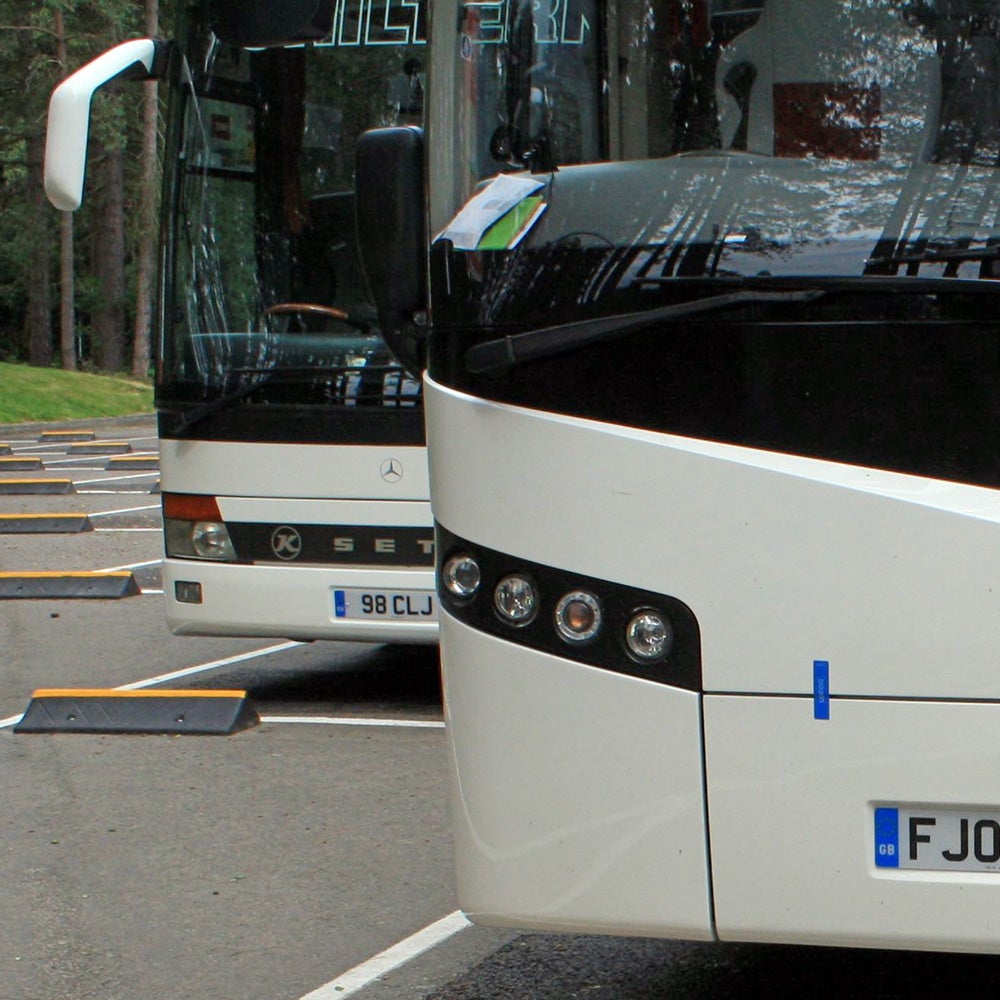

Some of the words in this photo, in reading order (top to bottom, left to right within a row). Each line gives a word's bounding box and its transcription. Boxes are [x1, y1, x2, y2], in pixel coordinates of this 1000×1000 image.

[361, 594, 387, 614] 98
[393, 595, 433, 616] CLJ
[878, 843, 895, 856] GB
